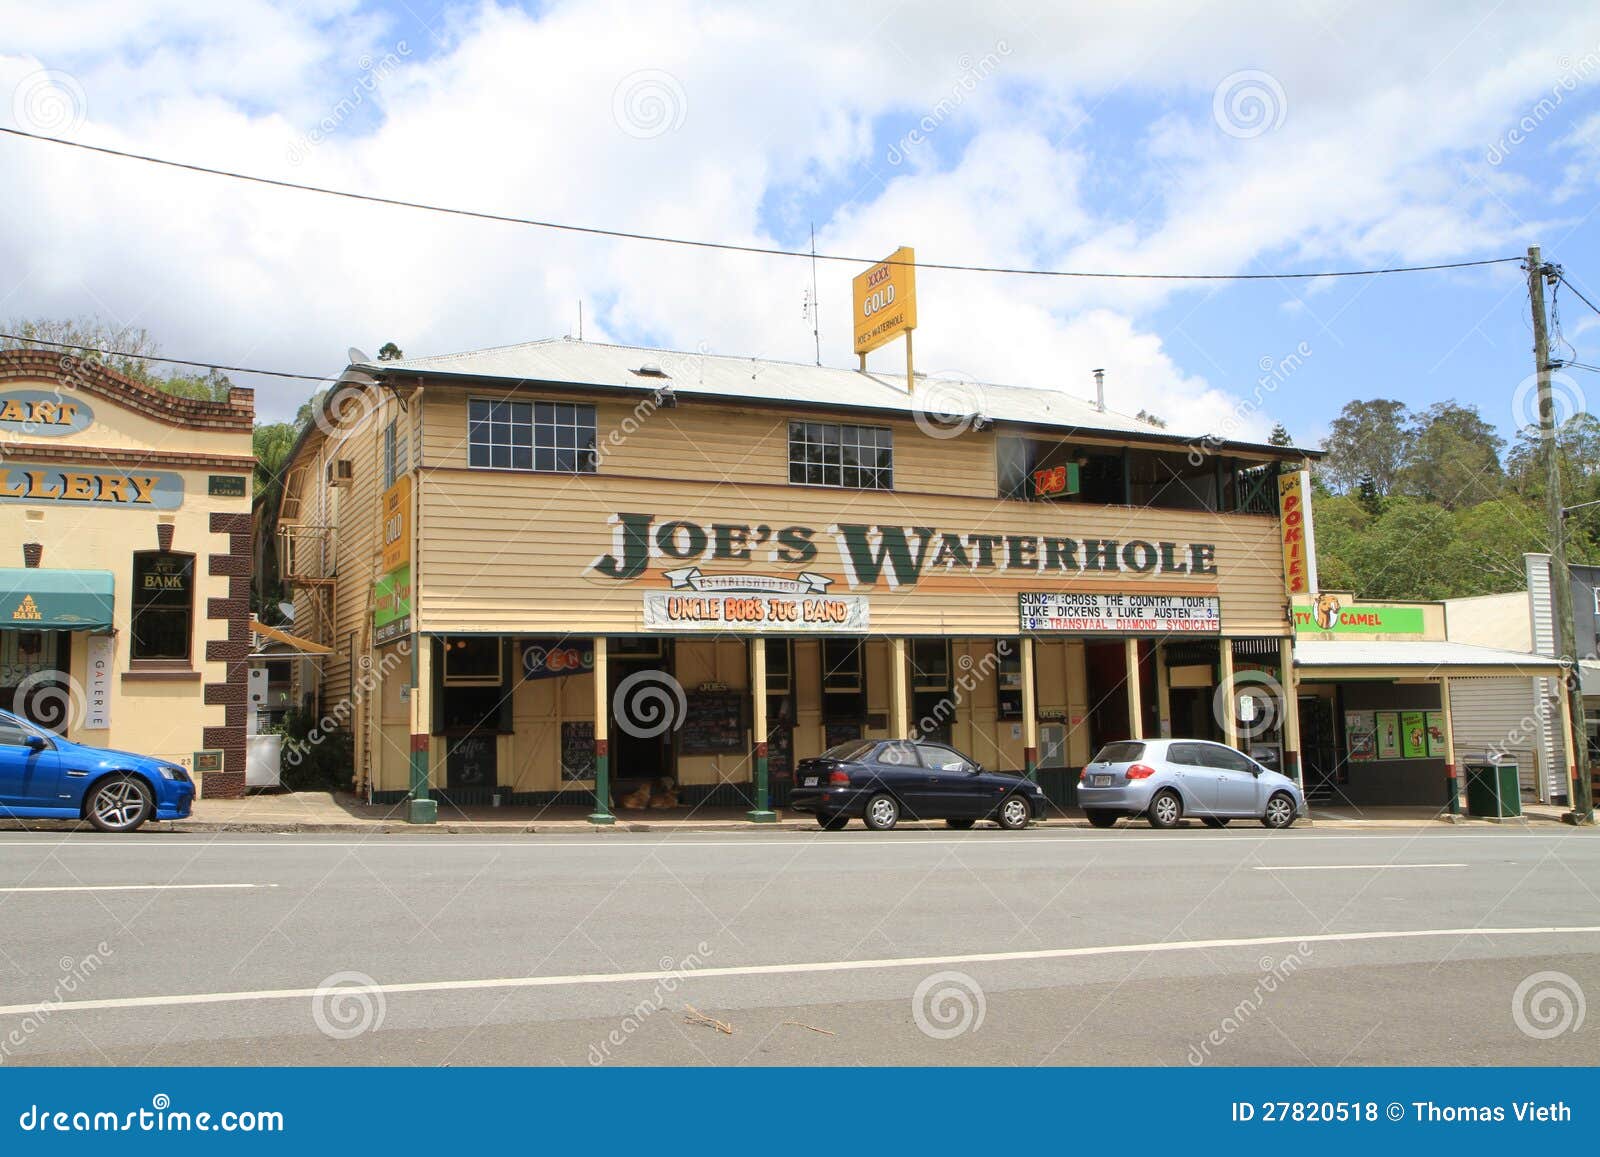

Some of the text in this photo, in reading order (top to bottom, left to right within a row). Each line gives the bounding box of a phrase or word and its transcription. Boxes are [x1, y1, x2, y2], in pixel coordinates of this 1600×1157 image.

[864, 284, 895, 317] GOLD
[872, 314, 904, 338] WATERHOLE
[0, 399, 78, 426] ART
[1034, 466, 1067, 496] TAB
[386, 512, 402, 545] GOLD
[581, 512, 1218, 590] JOE'S WATERHOLE
[1284, 495, 1304, 592] POKIES
[144, 575, 183, 588] BANK
[17, 604, 38, 613] ART
[668, 597, 720, 622] UNCLE
[768, 599, 797, 621] JUG
[804, 599, 847, 622] BAND
[1022, 605, 1049, 617] LUKE
[1057, 606, 1101, 617] DICKENS
[1118, 607, 1143, 618] LUKE
[1154, 608, 1191, 618] AUSTEN
[1105, 595, 1123, 606] THE
[1130, 596, 1172, 607] COUNTRY
[1181, 597, 1205, 607] TOUR
[12, 611, 42, 620] BANK
[1049, 618, 1108, 630] TRANSVAAL
[1116, 619, 1158, 630] DIAMOND
[1166, 619, 1218, 631] SYNDICATE
[1340, 612, 1382, 626] CAMEL
[527, 648, 594, 670] KENO
[92, 660, 105, 725] GALERIE
